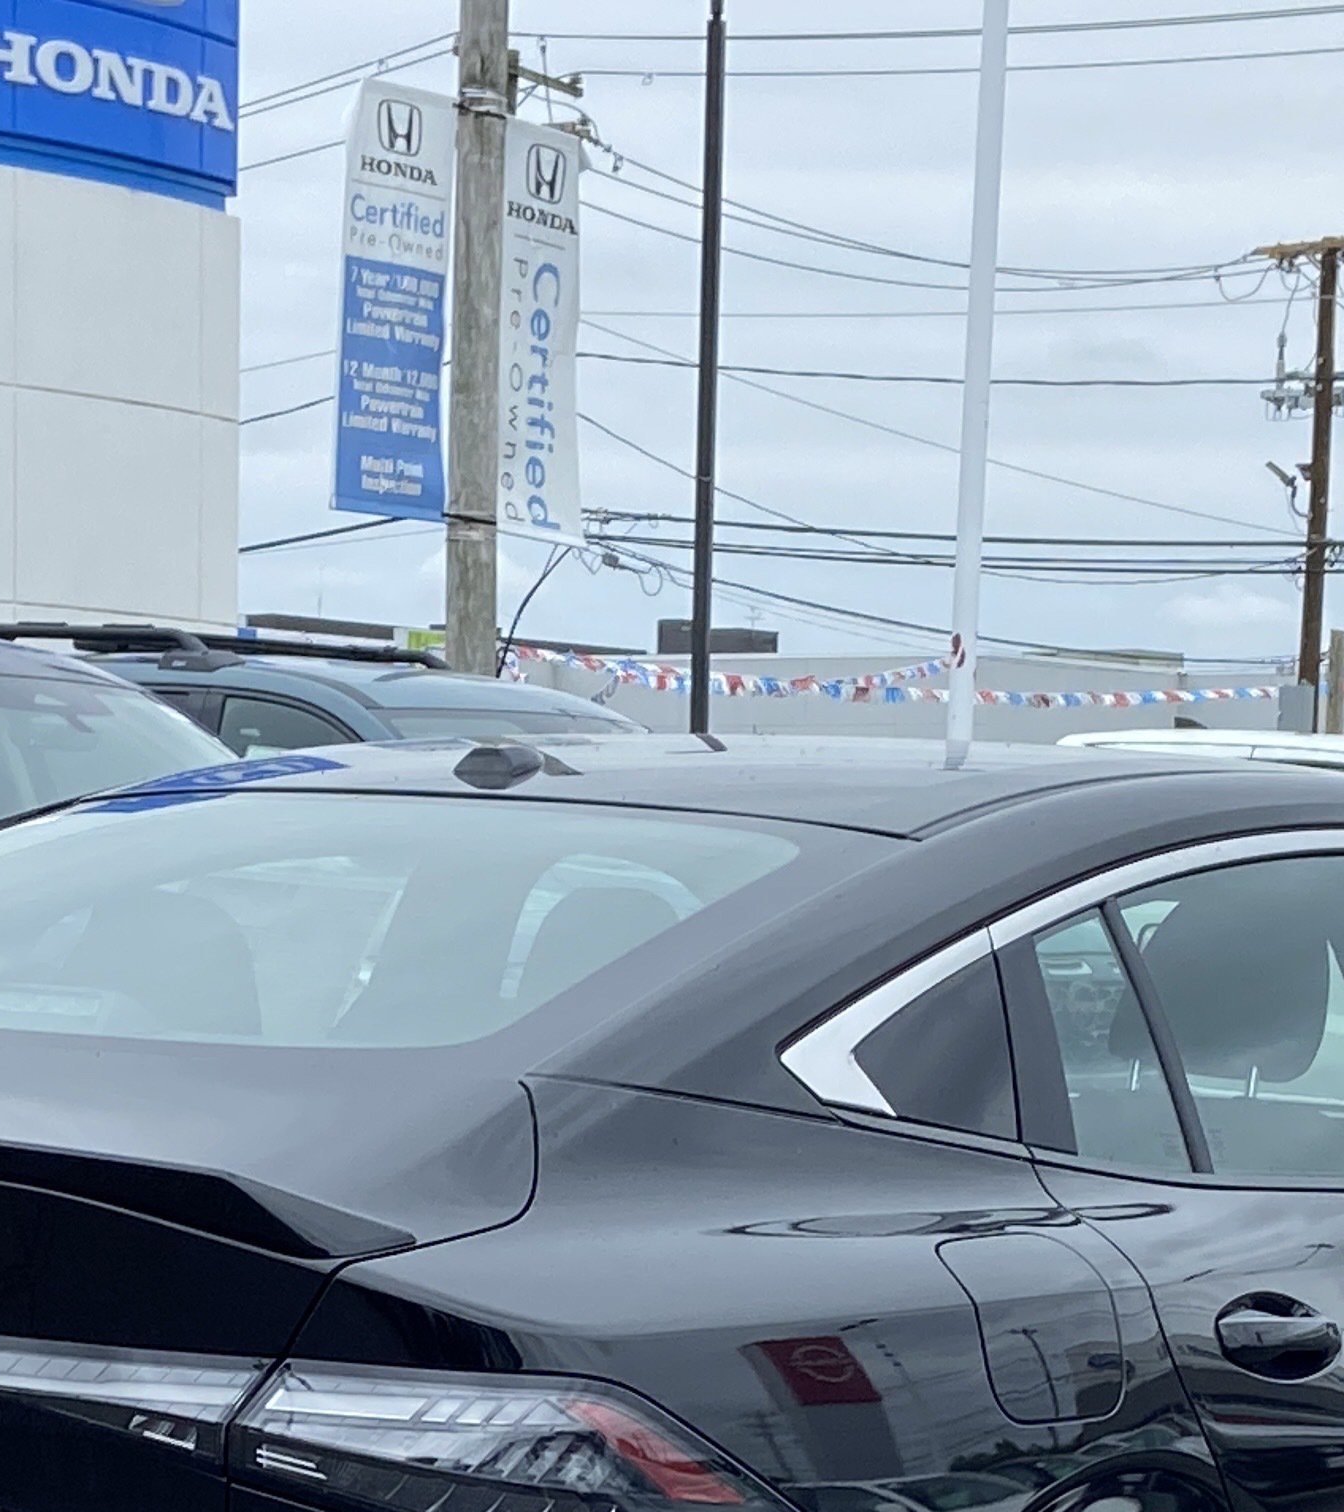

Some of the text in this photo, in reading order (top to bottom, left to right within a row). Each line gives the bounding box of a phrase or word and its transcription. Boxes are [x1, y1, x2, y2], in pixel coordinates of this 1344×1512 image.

[360, 154, 438, 186] HONDA
[350, 192, 446, 239] Certified
[507, 200, 578, 236] HONDA
[349, 225, 444, 261] Pre-Owned
[500, 256, 529, 522] Pre-Owned
[525, 262, 561, 531] Certified
